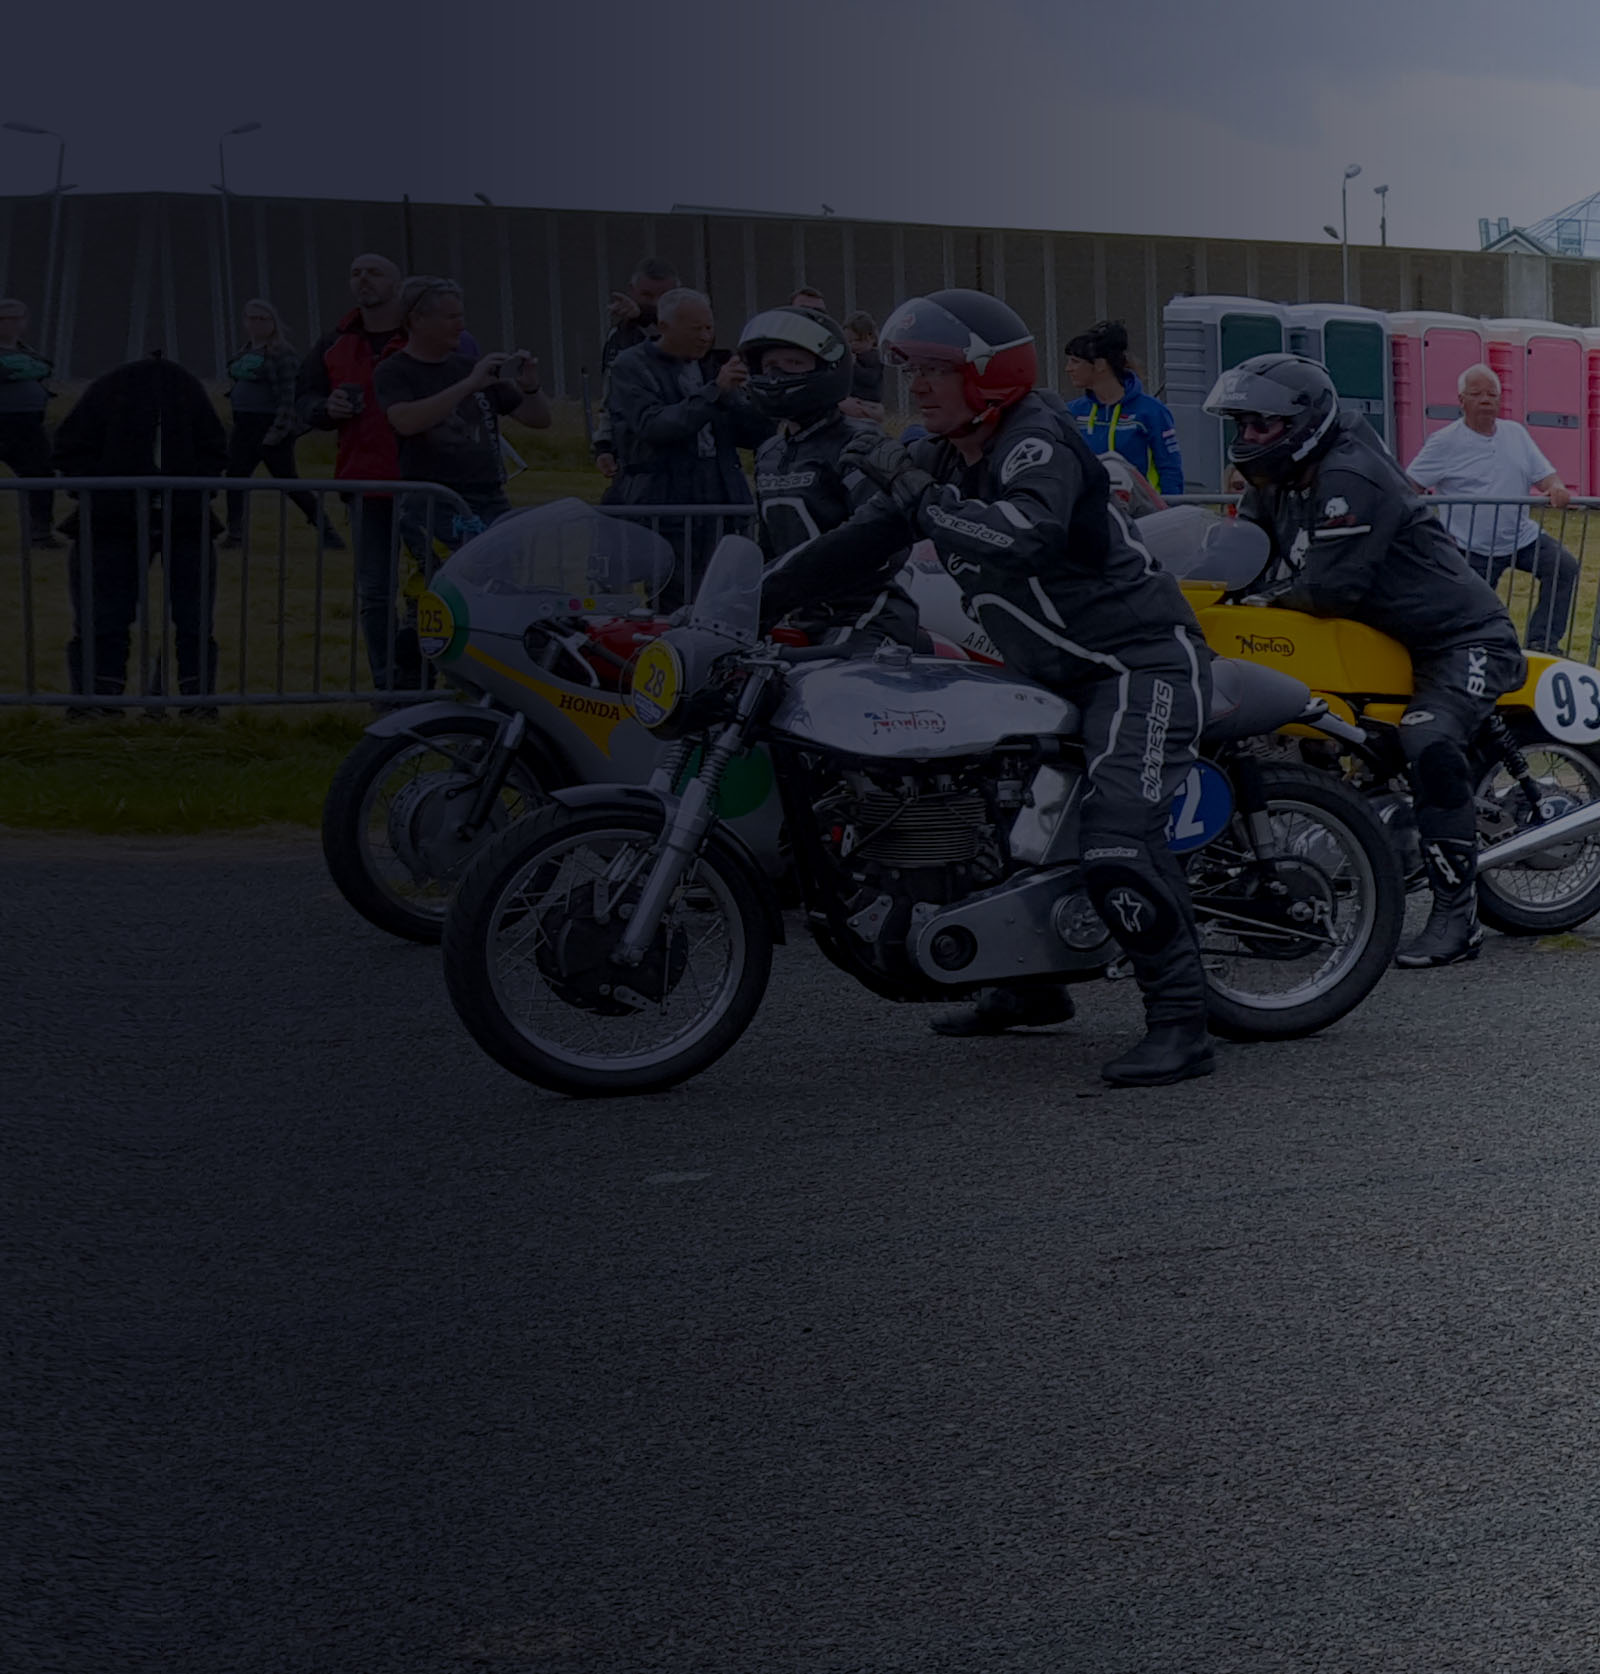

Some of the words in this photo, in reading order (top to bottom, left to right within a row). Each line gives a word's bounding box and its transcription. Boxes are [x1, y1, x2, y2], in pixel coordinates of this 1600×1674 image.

[1236, 634, 1295, 657] Norton
[645, 663, 666, 698] 28
[558, 694, 621, 721] HONDA
